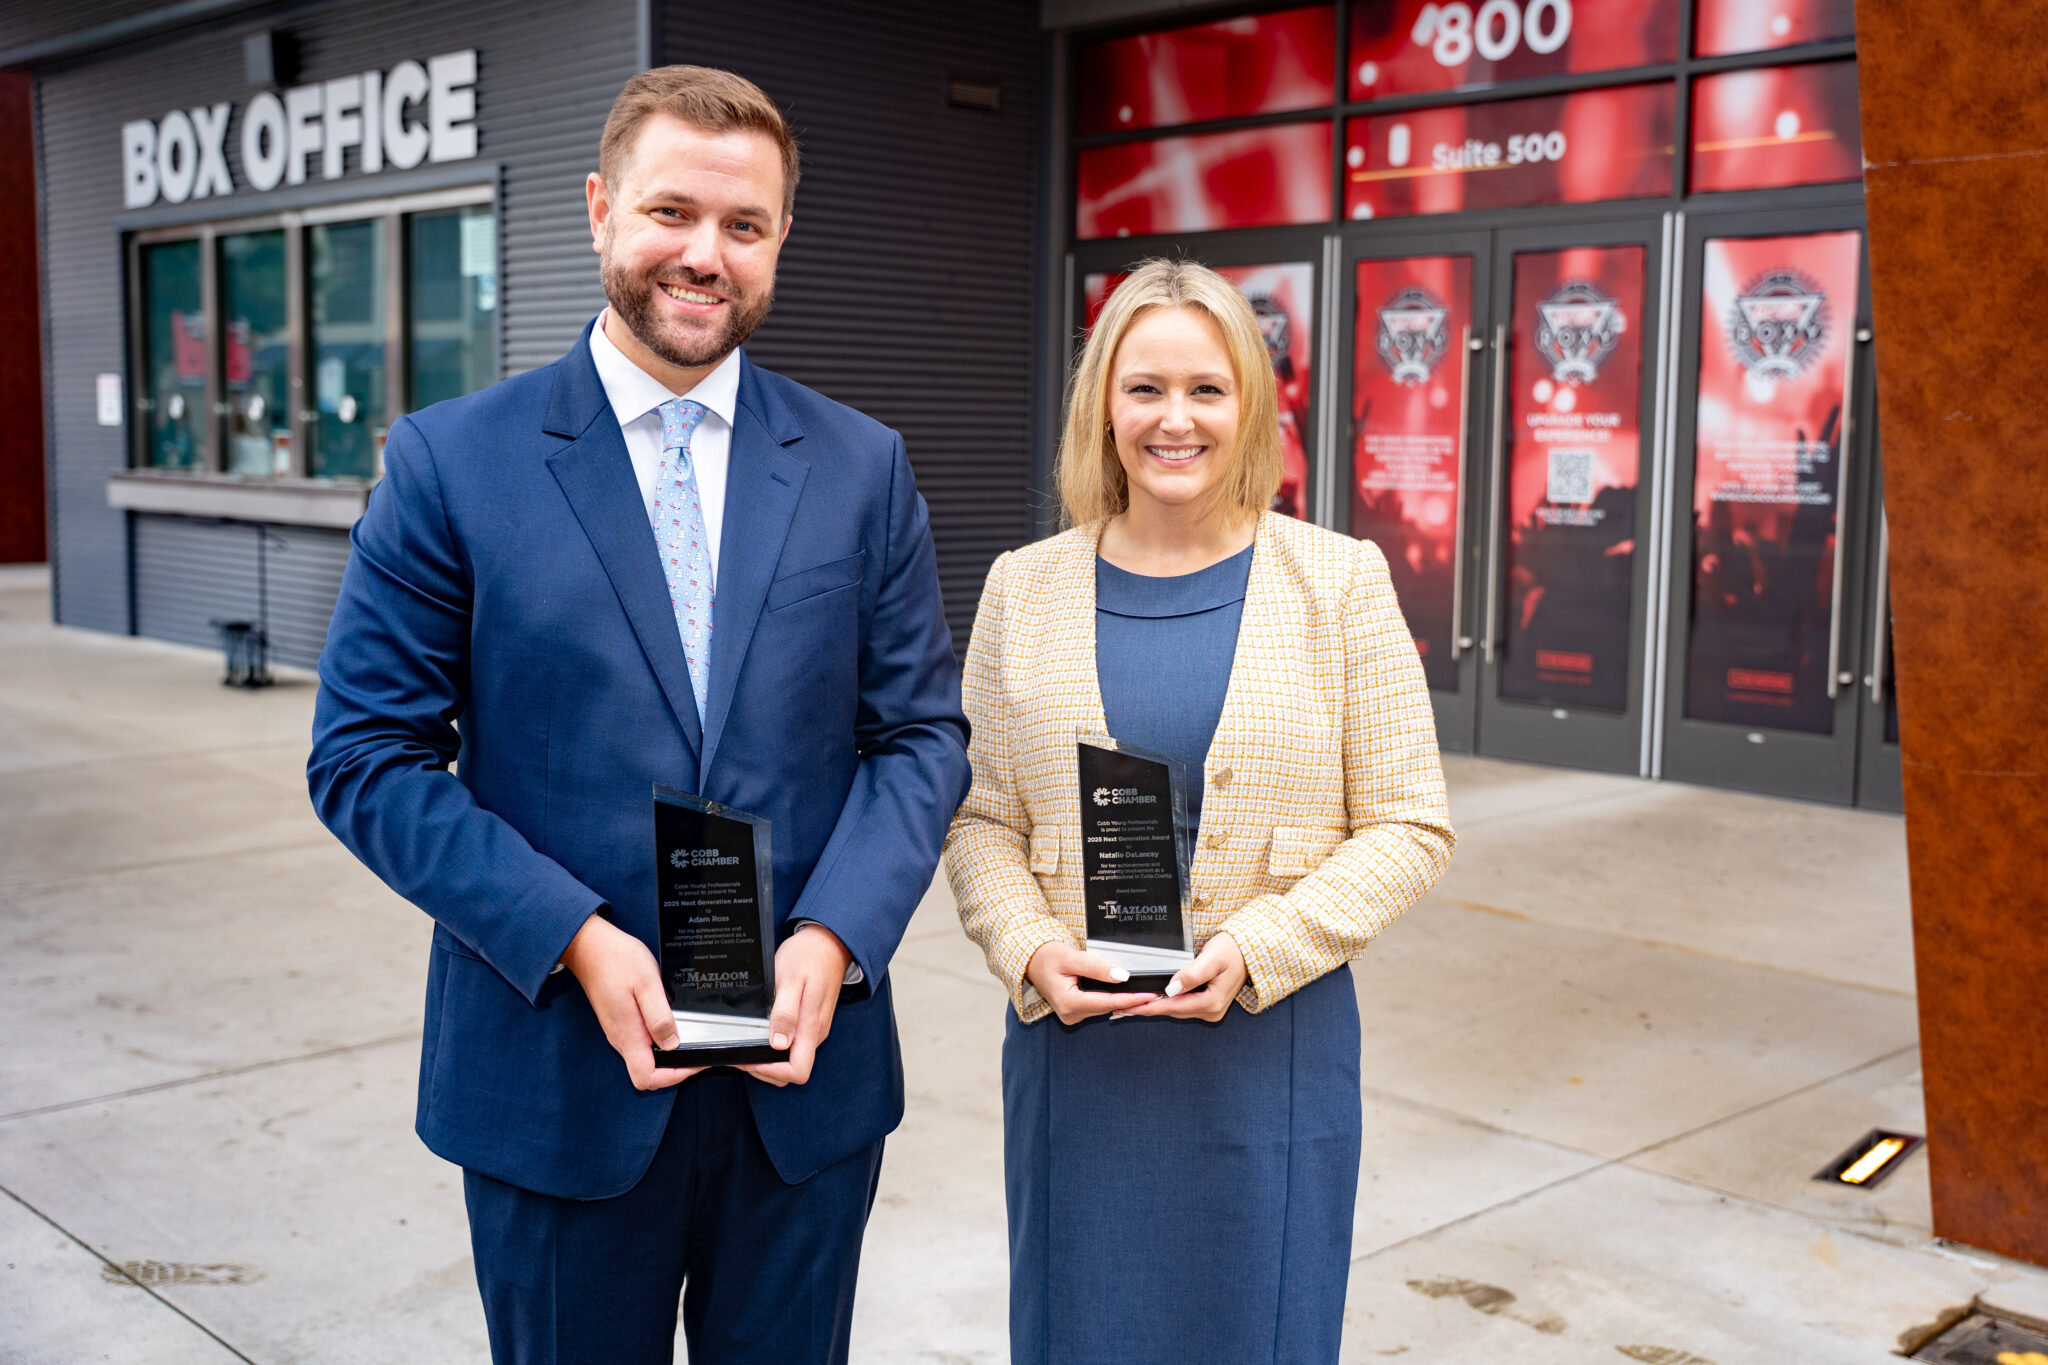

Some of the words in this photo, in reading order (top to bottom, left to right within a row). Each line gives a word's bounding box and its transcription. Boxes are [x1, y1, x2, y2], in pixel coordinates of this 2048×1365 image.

[122, 102, 235, 210] BOX
[241, 49, 478, 192] OFFICE
[1432, 138, 1501, 171] Suite
[1507, 130, 1567, 164] 500
[1585, 412, 1621, 427] YOUR
[1112, 788, 1137, 796] COBB
[1112, 795, 1156, 804] CHAMBER
[691, 849, 719, 857] COBB
[691, 857, 739, 866] CHAMBER
[698, 898, 731, 906] Generation
[1110, 905, 1167, 914] MAZLOOM
[687, 971, 748, 982] MAZLOOM
[715, 981, 733, 989] FIRM
